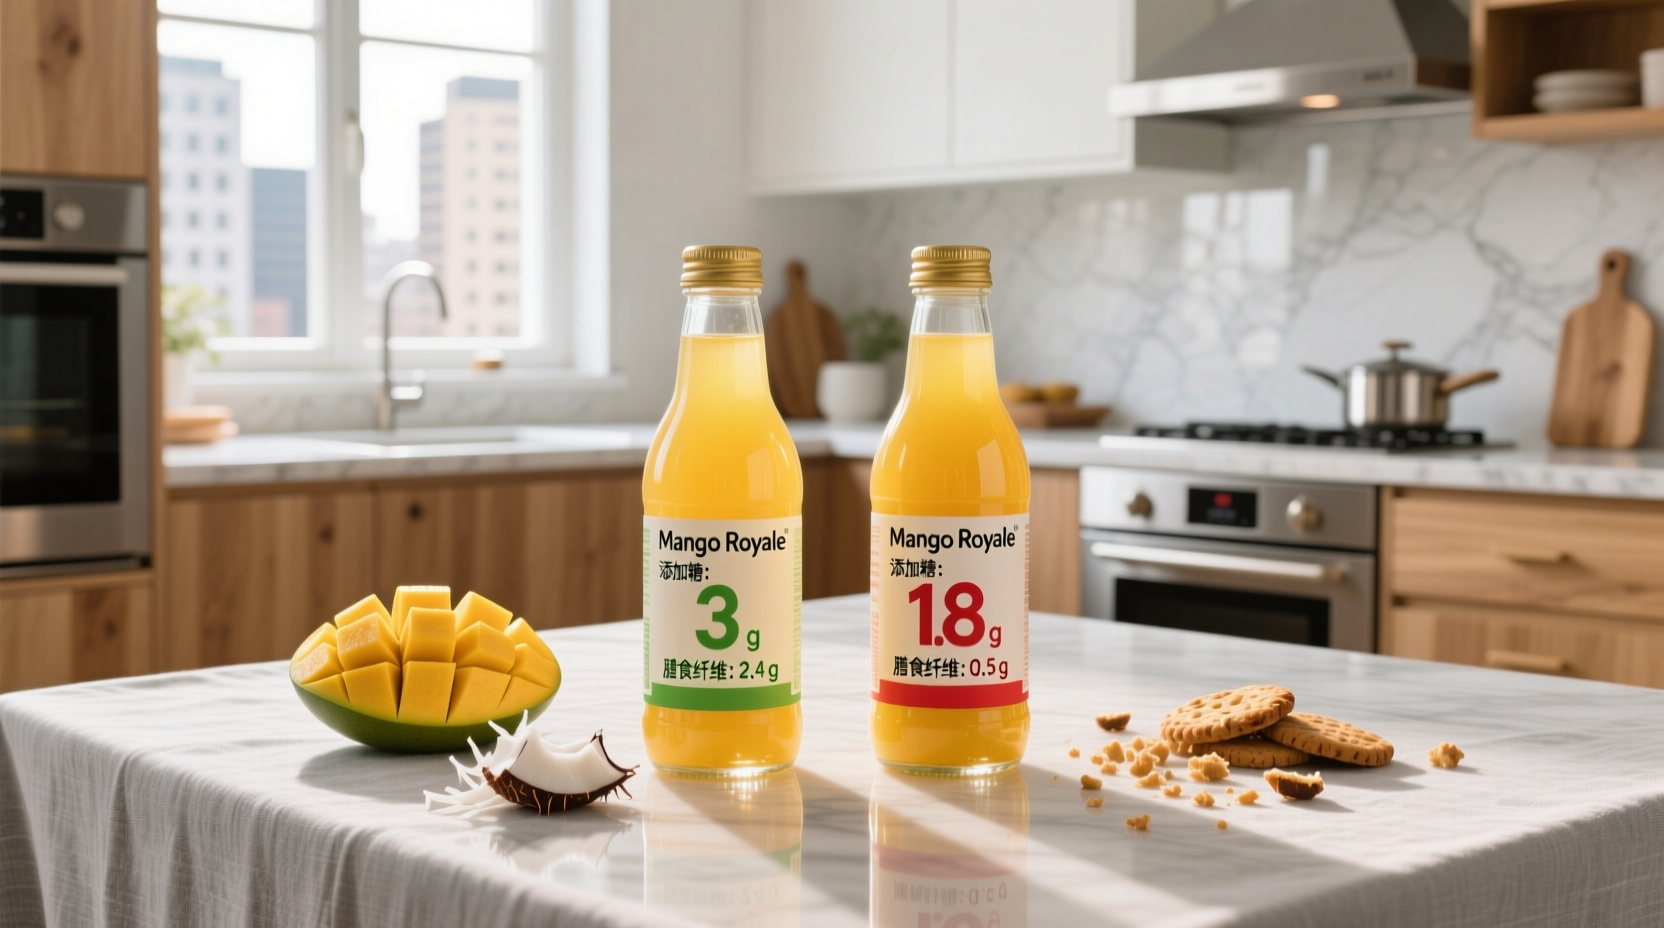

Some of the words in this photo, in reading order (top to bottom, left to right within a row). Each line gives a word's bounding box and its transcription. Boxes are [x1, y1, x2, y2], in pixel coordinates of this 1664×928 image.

[659, 530, 721, 557] Mango
[726, 530, 786, 557] Royale
[890, 527, 954, 554] Mango
[958, 527, 1016, 554] Royale
[695, 584, 740, 650] 3
[908, 581, 986, 647] 1.8
